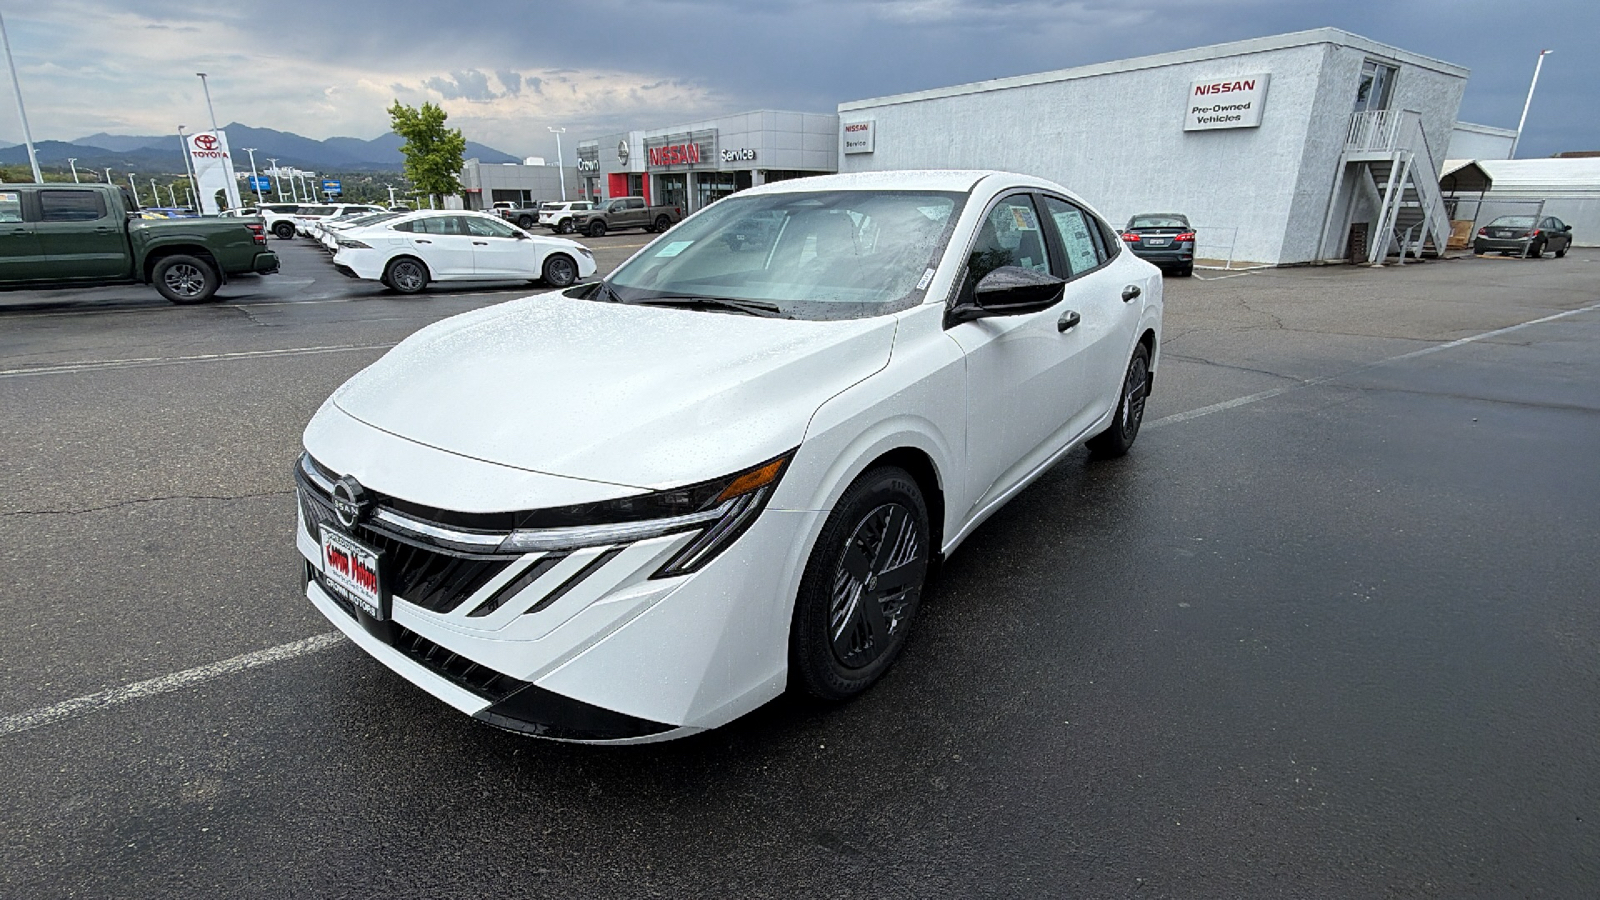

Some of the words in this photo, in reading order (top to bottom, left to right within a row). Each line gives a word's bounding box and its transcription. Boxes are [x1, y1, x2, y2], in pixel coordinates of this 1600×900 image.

[1194, 80, 1255, 95] NISSAN
[1191, 102, 1251, 113] Pre-Owned
[1197, 114, 1242, 124] Vehicles
[845, 124, 868, 132] NISSAN
[649, 143, 699, 166] NISSAN
[721, 148, 755, 162] Service
